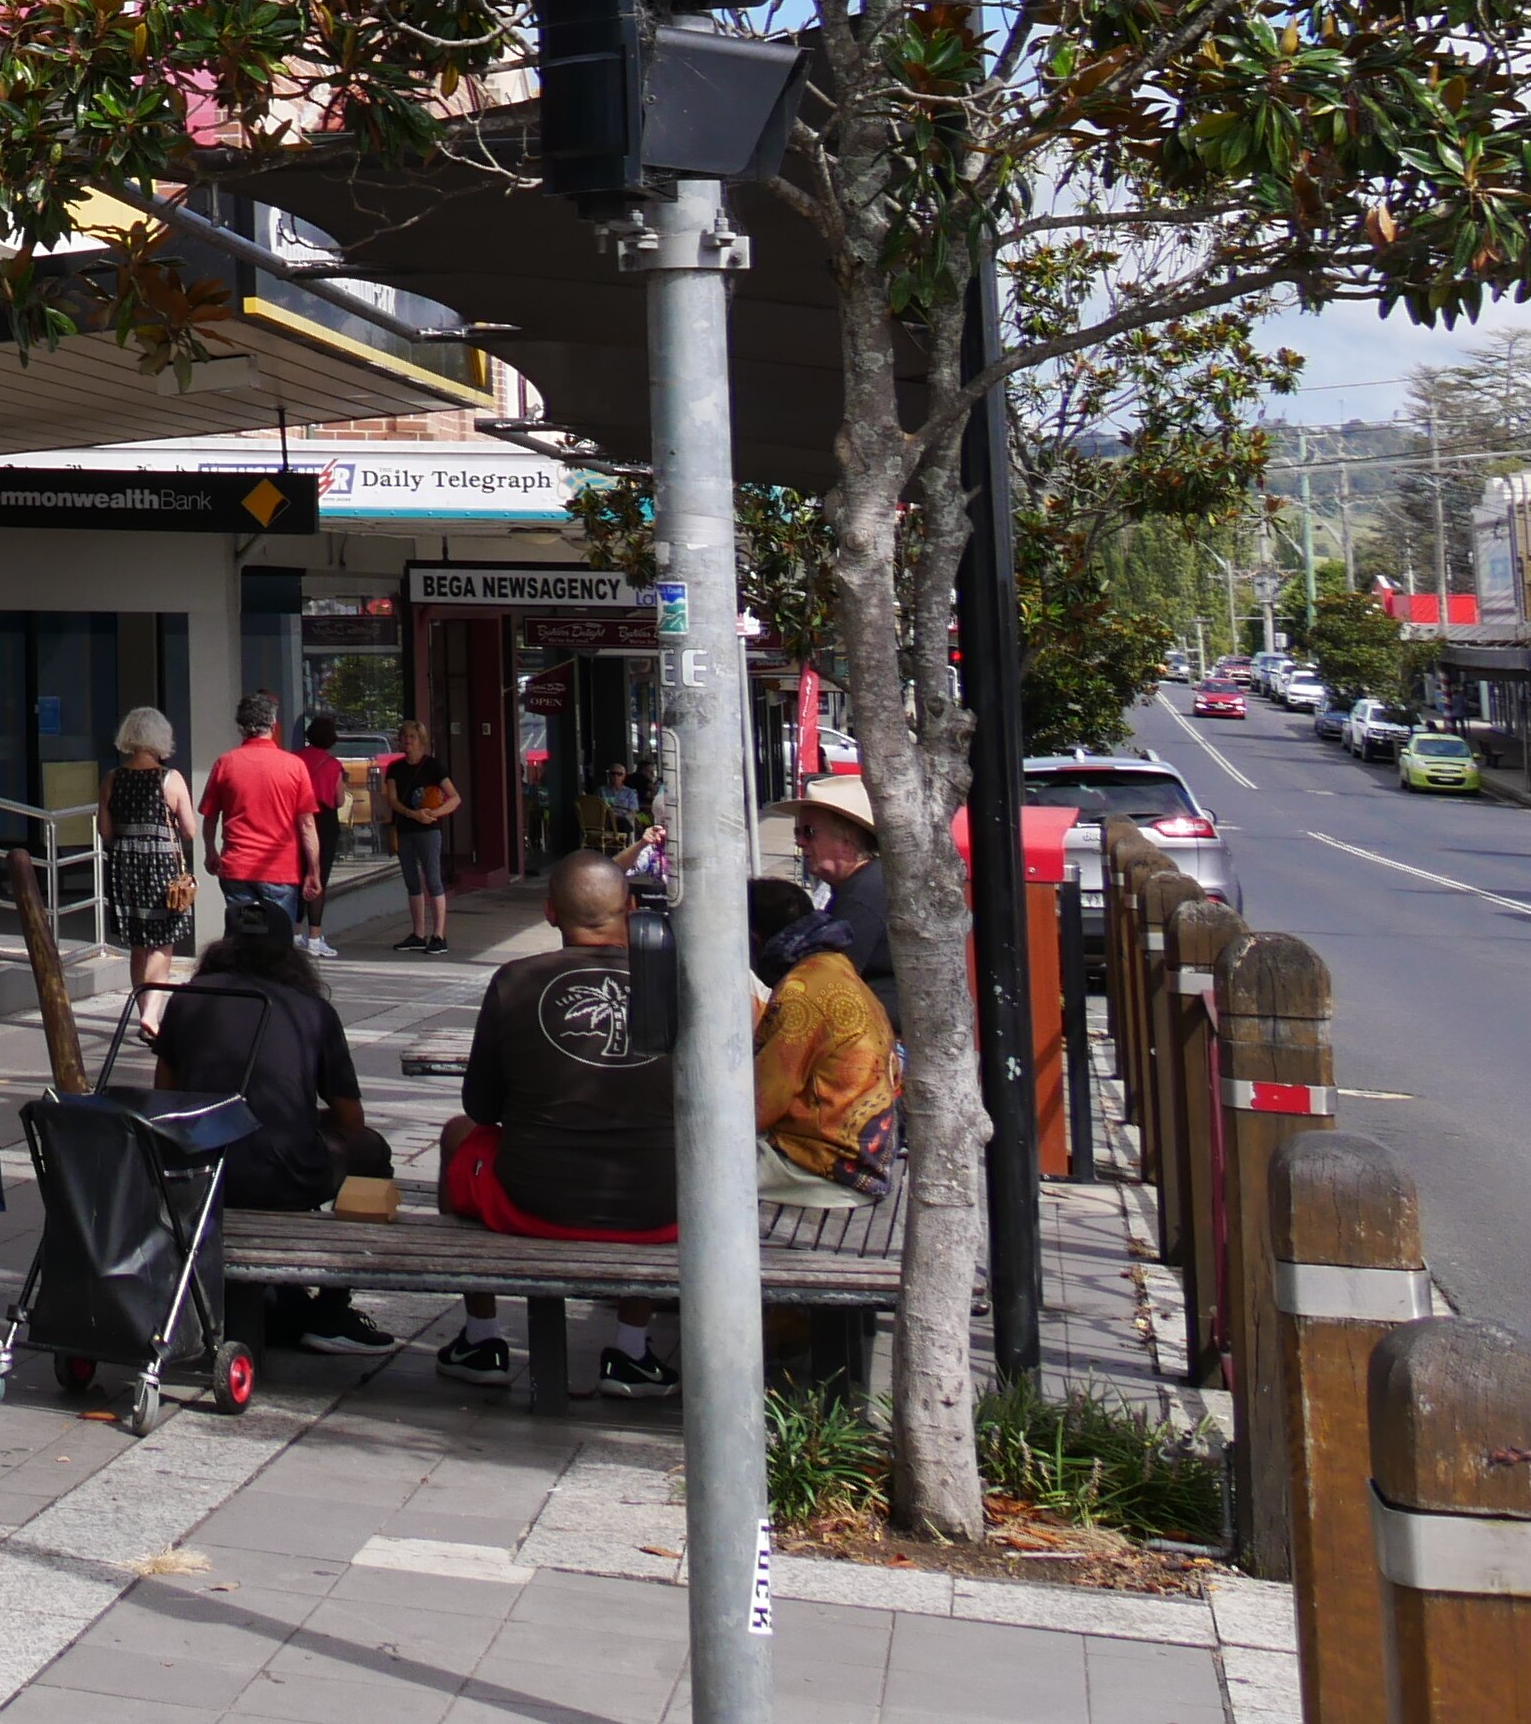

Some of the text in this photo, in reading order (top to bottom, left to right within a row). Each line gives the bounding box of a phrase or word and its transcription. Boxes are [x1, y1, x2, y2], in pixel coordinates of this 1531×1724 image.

[361, 469, 424, 492] Daily
[430, 470, 554, 494] Telegraph
[423, 575, 477, 598] BEGA
[482, 576, 621, 601] NEWSAGENCY
[530, 697, 563, 707] OPEN
